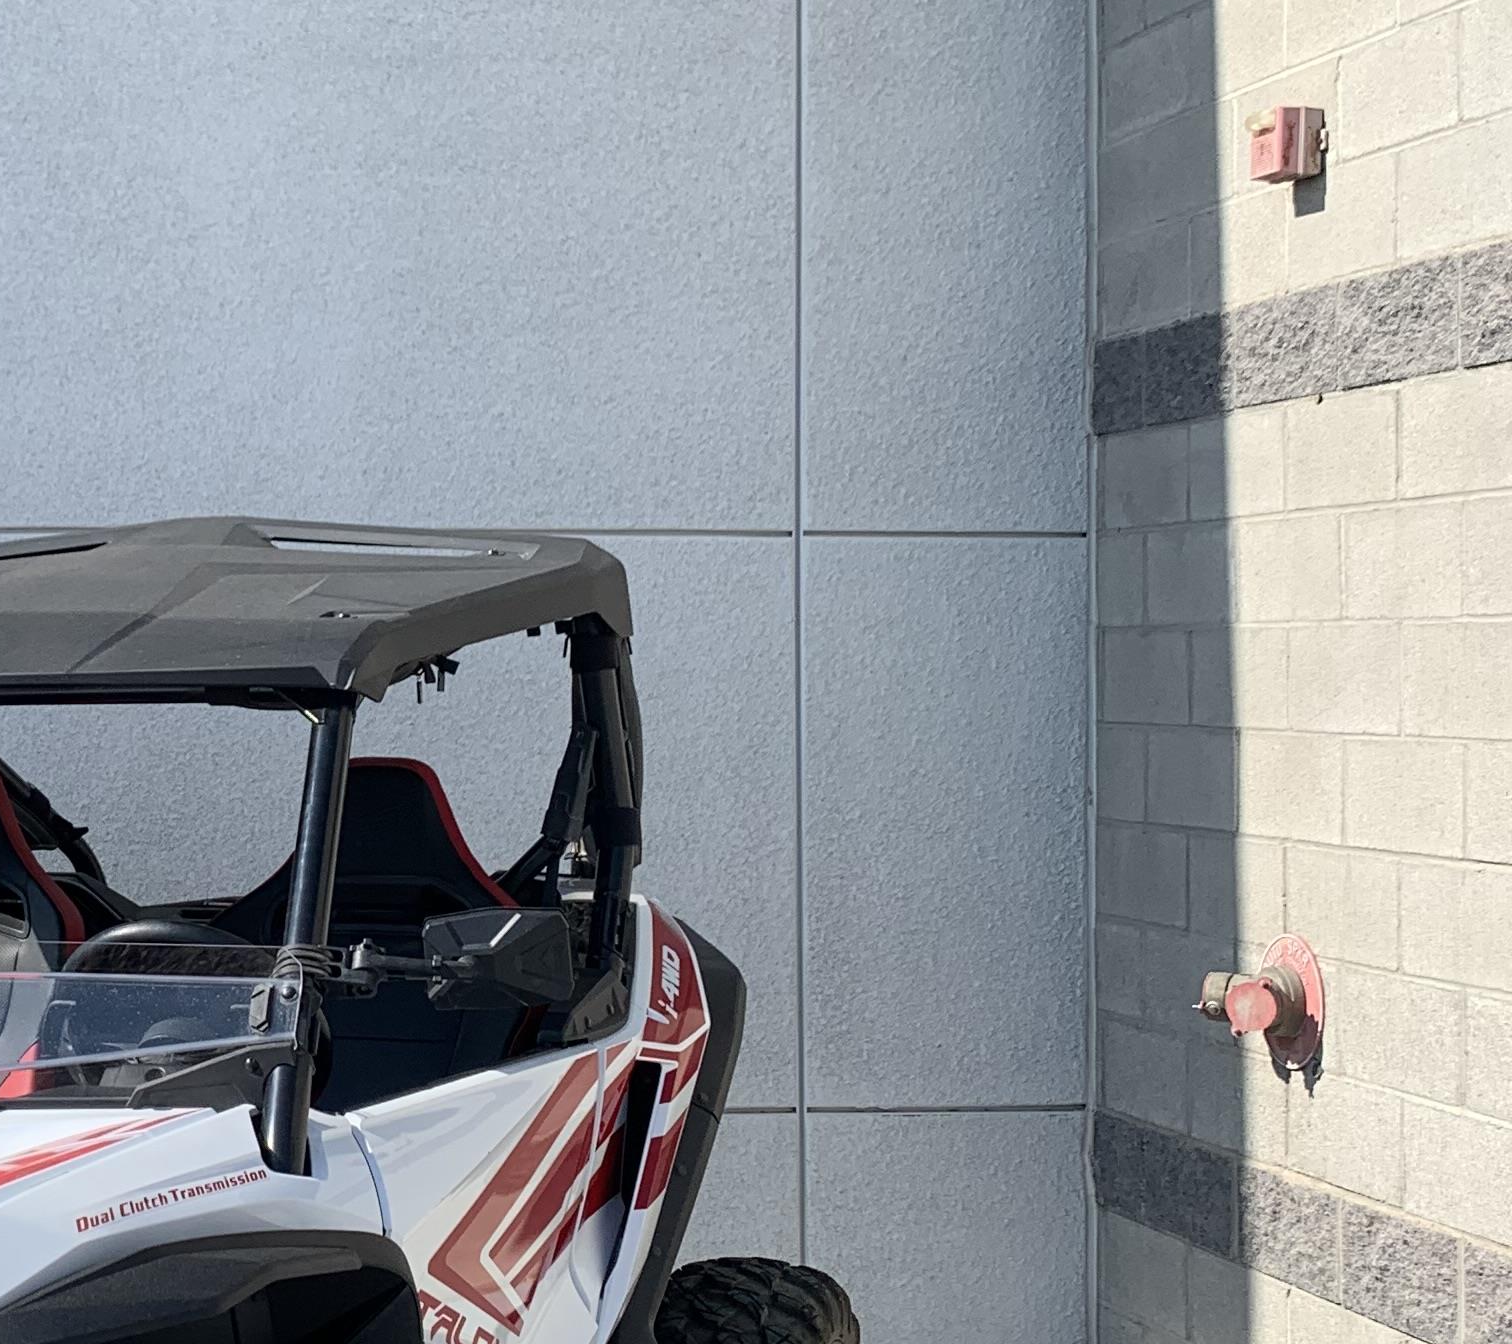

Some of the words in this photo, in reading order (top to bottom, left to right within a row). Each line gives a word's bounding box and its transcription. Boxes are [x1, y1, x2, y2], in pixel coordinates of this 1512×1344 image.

[75, 1207, 115, 1233] Dual
[119, 1192, 168, 1218] Clutch
[168, 1168, 268, 1203] Transmission
